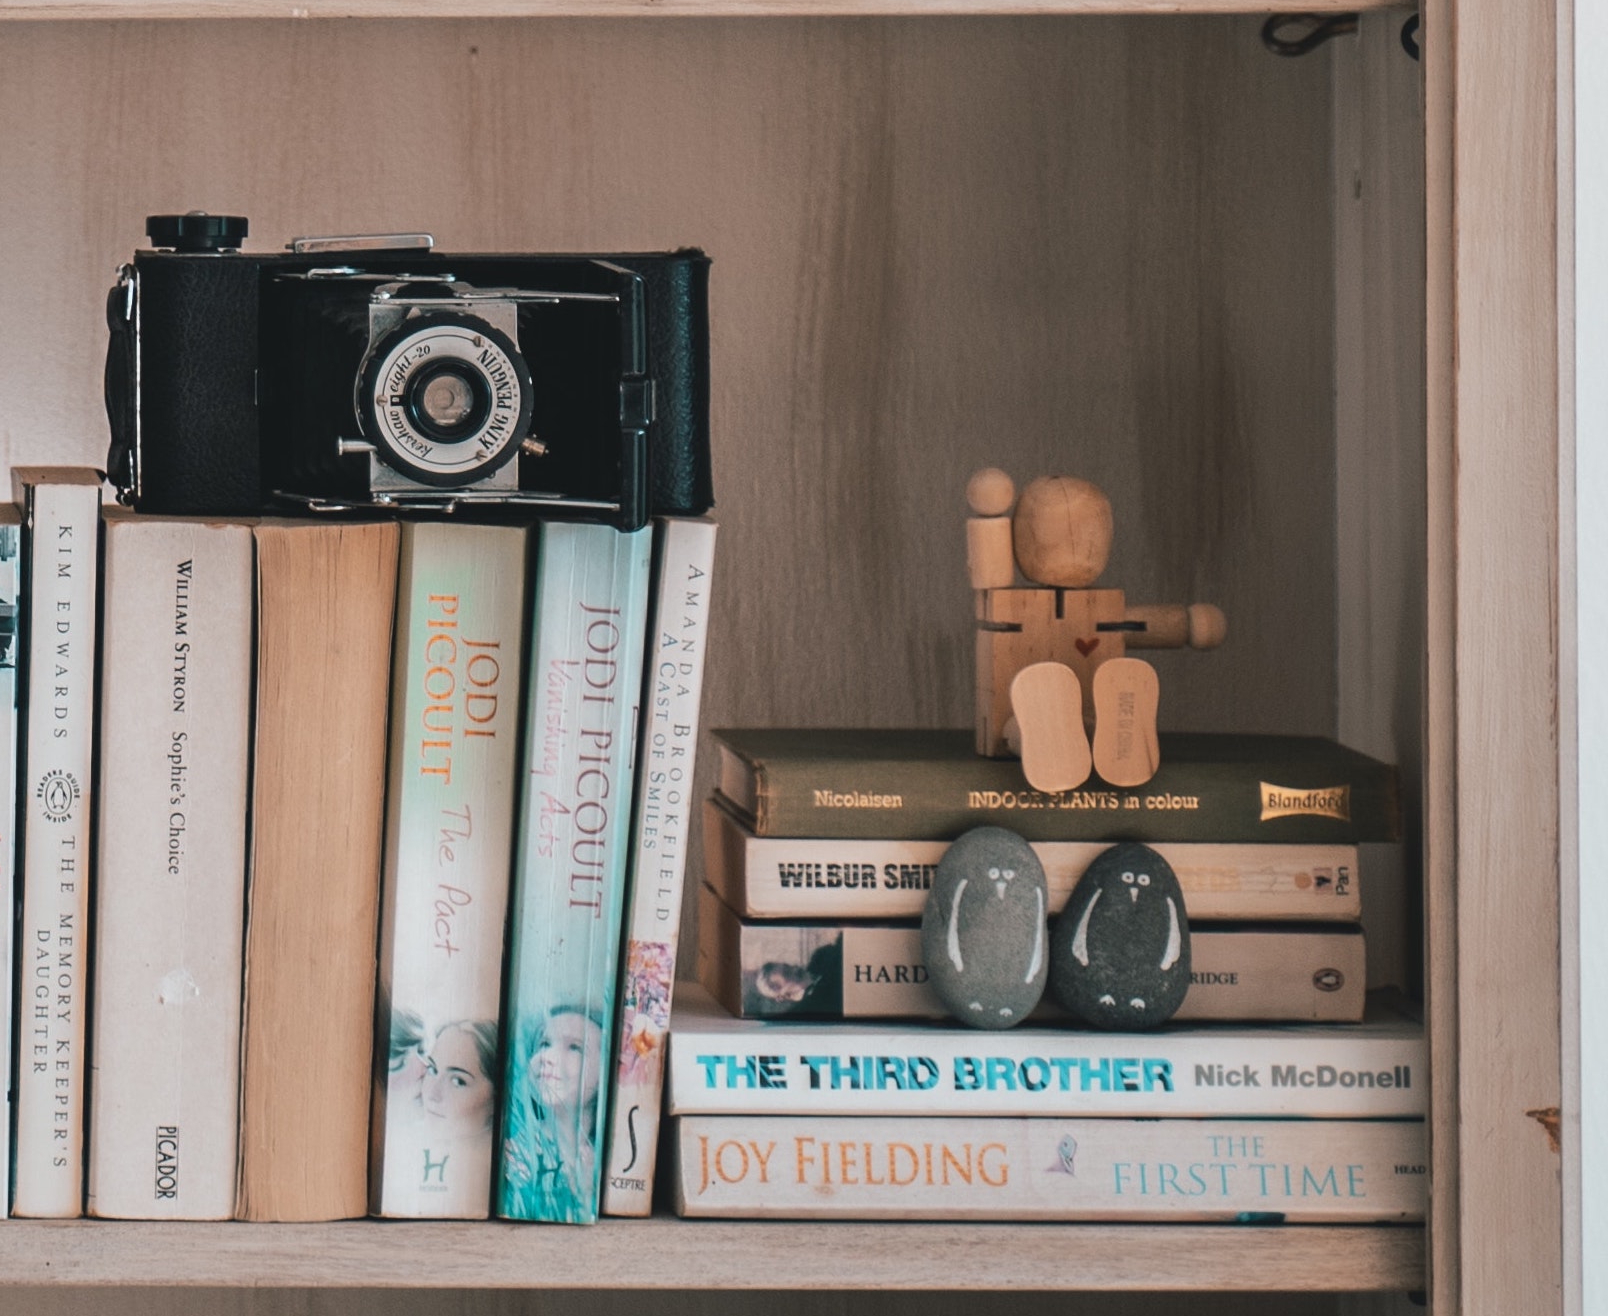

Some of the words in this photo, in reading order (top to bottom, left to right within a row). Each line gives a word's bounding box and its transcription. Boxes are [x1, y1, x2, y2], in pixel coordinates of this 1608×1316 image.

[175, 558, 193, 635] WILLIAM
[172, 641, 190, 712] STYRON
[168, 731, 189, 806] Sophie's
[813, 790, 902, 808] Nicolaisen
[168, 812, 187, 873] Choice
[697, 1056, 789, 1089] THE
[800, 1057, 938, 1090] THIRD
[954, 1058, 1173, 1092] BROTHER
[1194, 1064, 1259, 1087] Nick
[1272, 1066, 1410, 1088] McDonell
[158, 1125, 177, 1198] PICADOR
